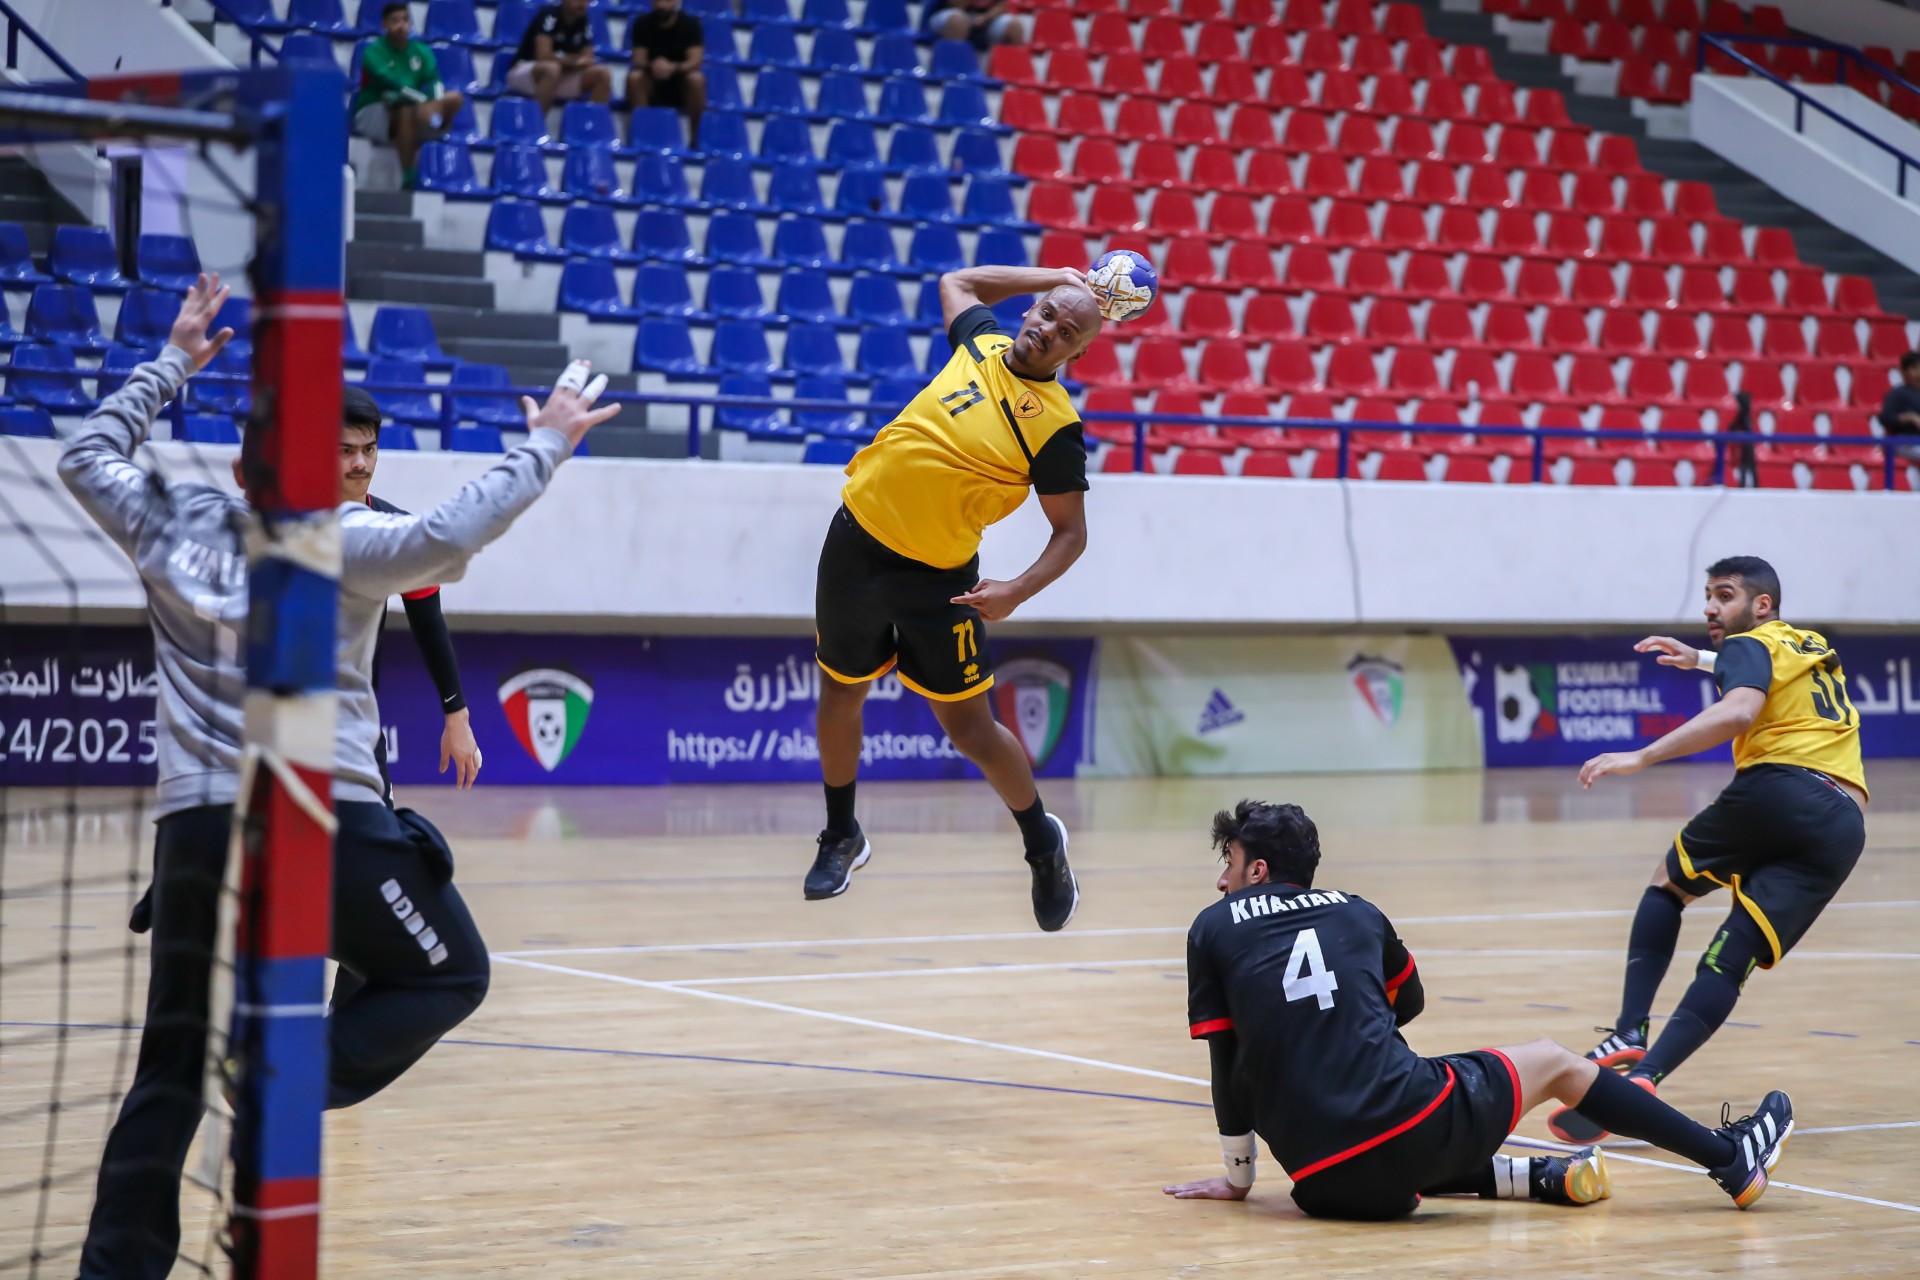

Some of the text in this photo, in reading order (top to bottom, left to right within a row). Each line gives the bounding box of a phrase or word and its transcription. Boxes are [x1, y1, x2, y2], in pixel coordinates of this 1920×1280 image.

[1557, 687, 1665, 714] FOOTBALL
[0, 718, 158, 765] 4/2025
[1558, 715, 1634, 742] VISION
[1281, 927, 1339, 1011] 4
